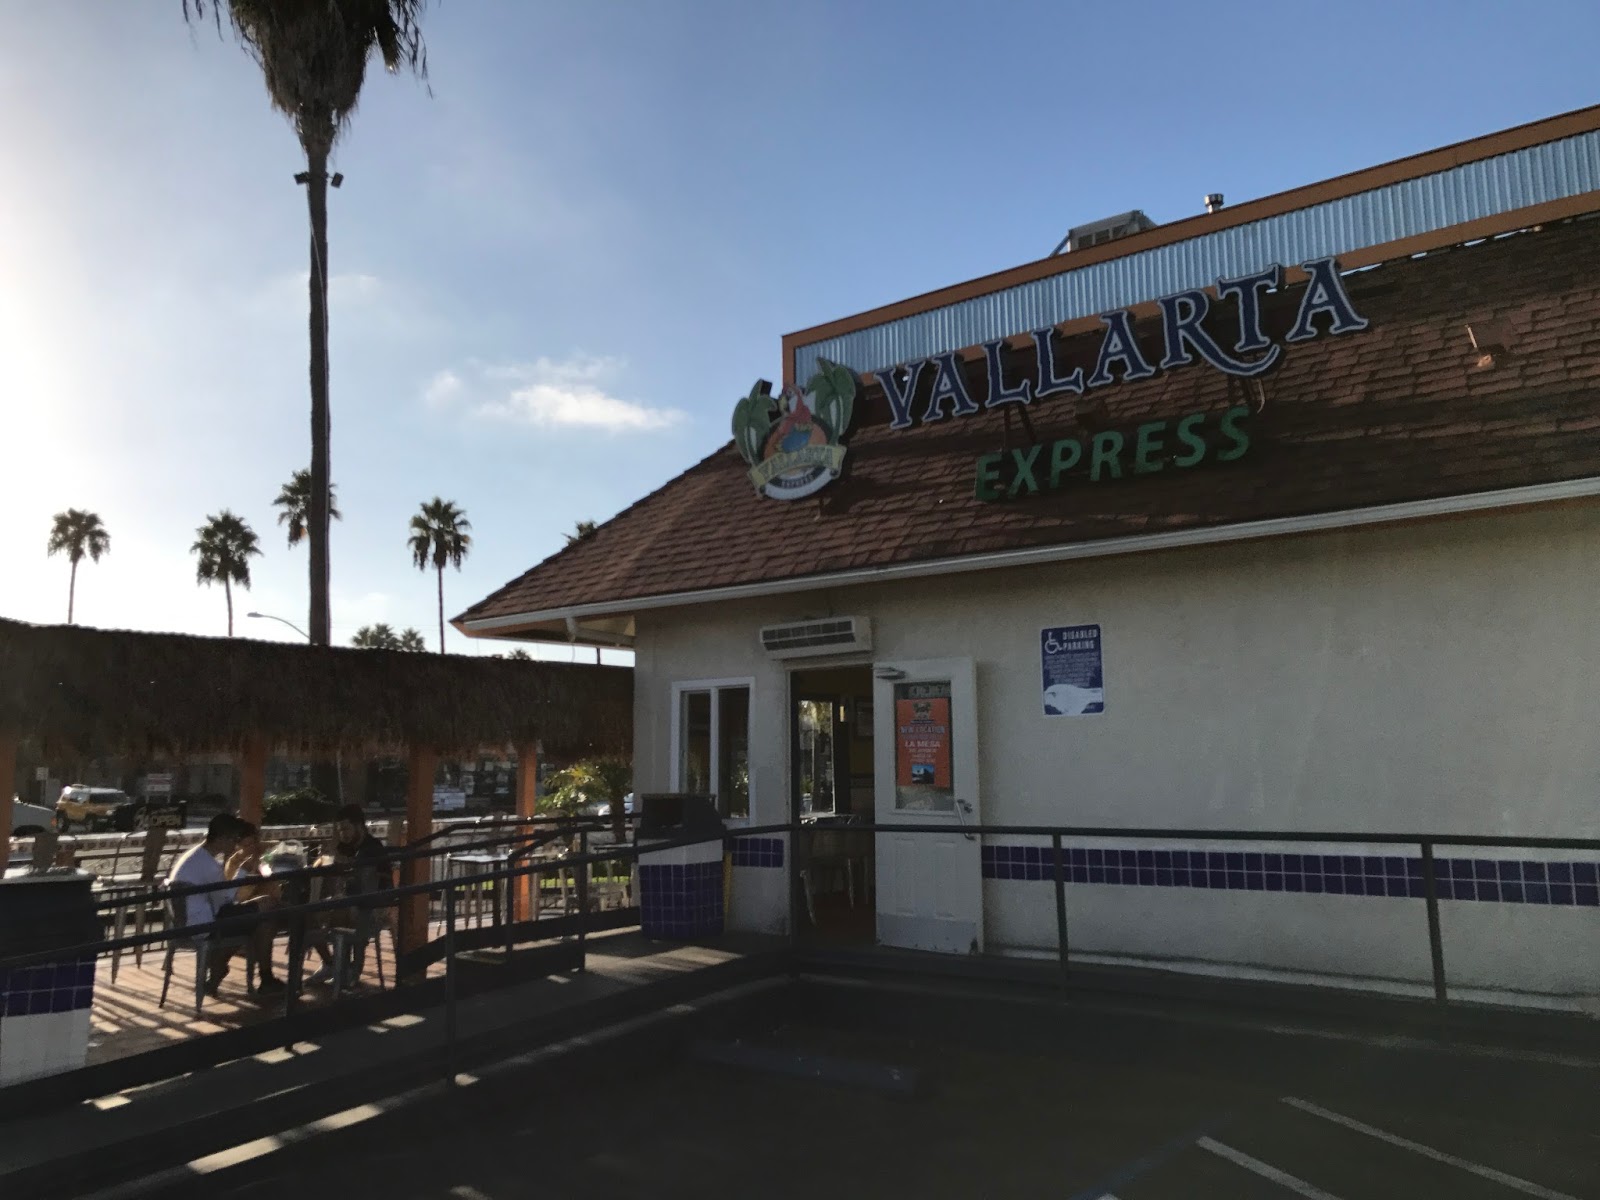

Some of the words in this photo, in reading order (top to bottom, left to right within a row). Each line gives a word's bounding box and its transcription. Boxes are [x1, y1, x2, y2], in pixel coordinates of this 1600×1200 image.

[876, 258, 1369, 429] VALLARTA
[974, 406, 1252, 502] EXPRESS
[1062, 629, 1098, 640] DISABLED
[1062, 640, 1095, 651] PARKING
